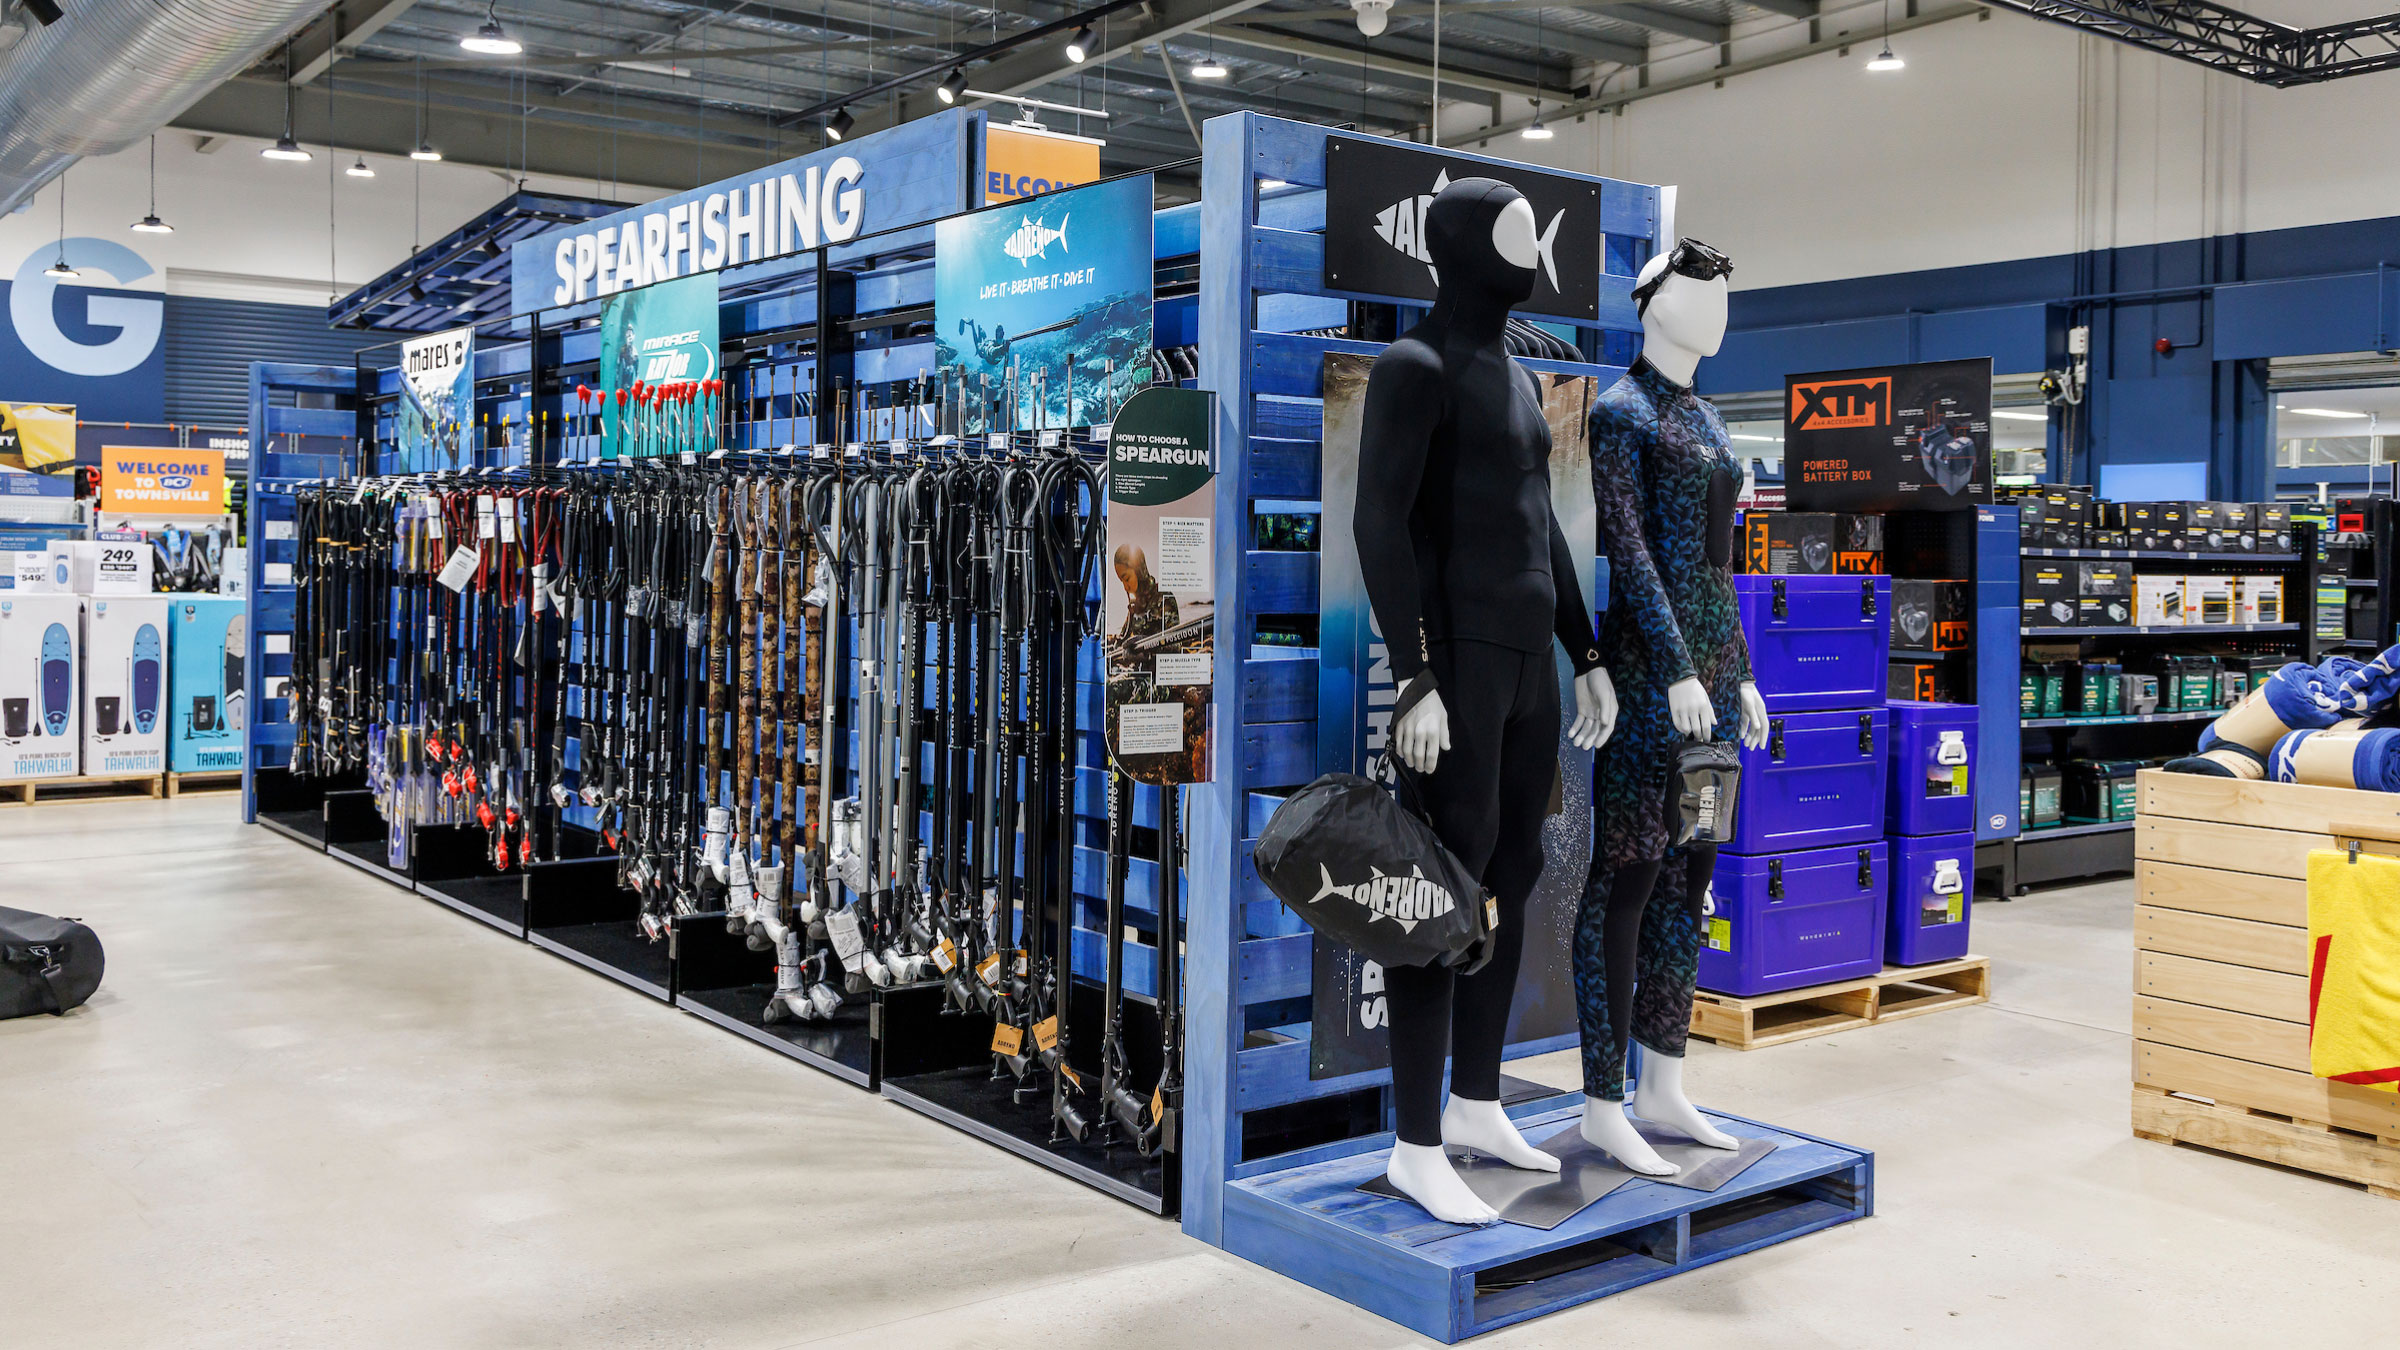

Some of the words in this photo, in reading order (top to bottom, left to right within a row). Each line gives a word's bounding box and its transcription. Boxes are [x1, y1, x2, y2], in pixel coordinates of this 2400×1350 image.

[988, 171, 1075, 197] ELCO
[554, 156, 866, 306] SPEARFISHING
[1009, 225, 1050, 258] ADRENO
[980, 283, 997, 300] LIVE
[999, 281, 1007, 297] IT
[1010, 276, 1049, 295] BREATHE
[1051, 273, 1060, 289] IT
[1063, 272, 1084, 286] DIVE
[1085, 268, 1095, 284] IT
[9, 237, 164, 377] G
[642, 330, 700, 352] MIRAGE
[409, 342, 449, 374] mares
[1793, 381, 1888, 427] XTM
[208, 438, 249, 450] INSHO
[1115, 434, 1136, 443] HOW
[1136, 434, 1148, 443] TO
[1148, 436, 1182, 445] CHOOSE
[1115, 446, 1209, 466] SPEARGUN
[116, 461, 210, 476] WELCOME
[1803, 460, 1849, 471] POWERED
[135, 478, 155, 488] TO
[161, 478, 192, 488] BCF
[1803, 471, 1848, 483] BATTERY
[1851, 470, 1872, 481] BOX
[115, 488, 210, 501] TOWNSVILLE
[1757, 494, 1787, 502] Access
[1165, 626, 1199, 643] POSEIDON
[14, 758, 72, 775] TAHWALHI
[104, 755, 160, 771] TAHWALHI
[196, 751, 243, 766] TAHWALH
[1354, 876, 1446, 920] ADRENO
